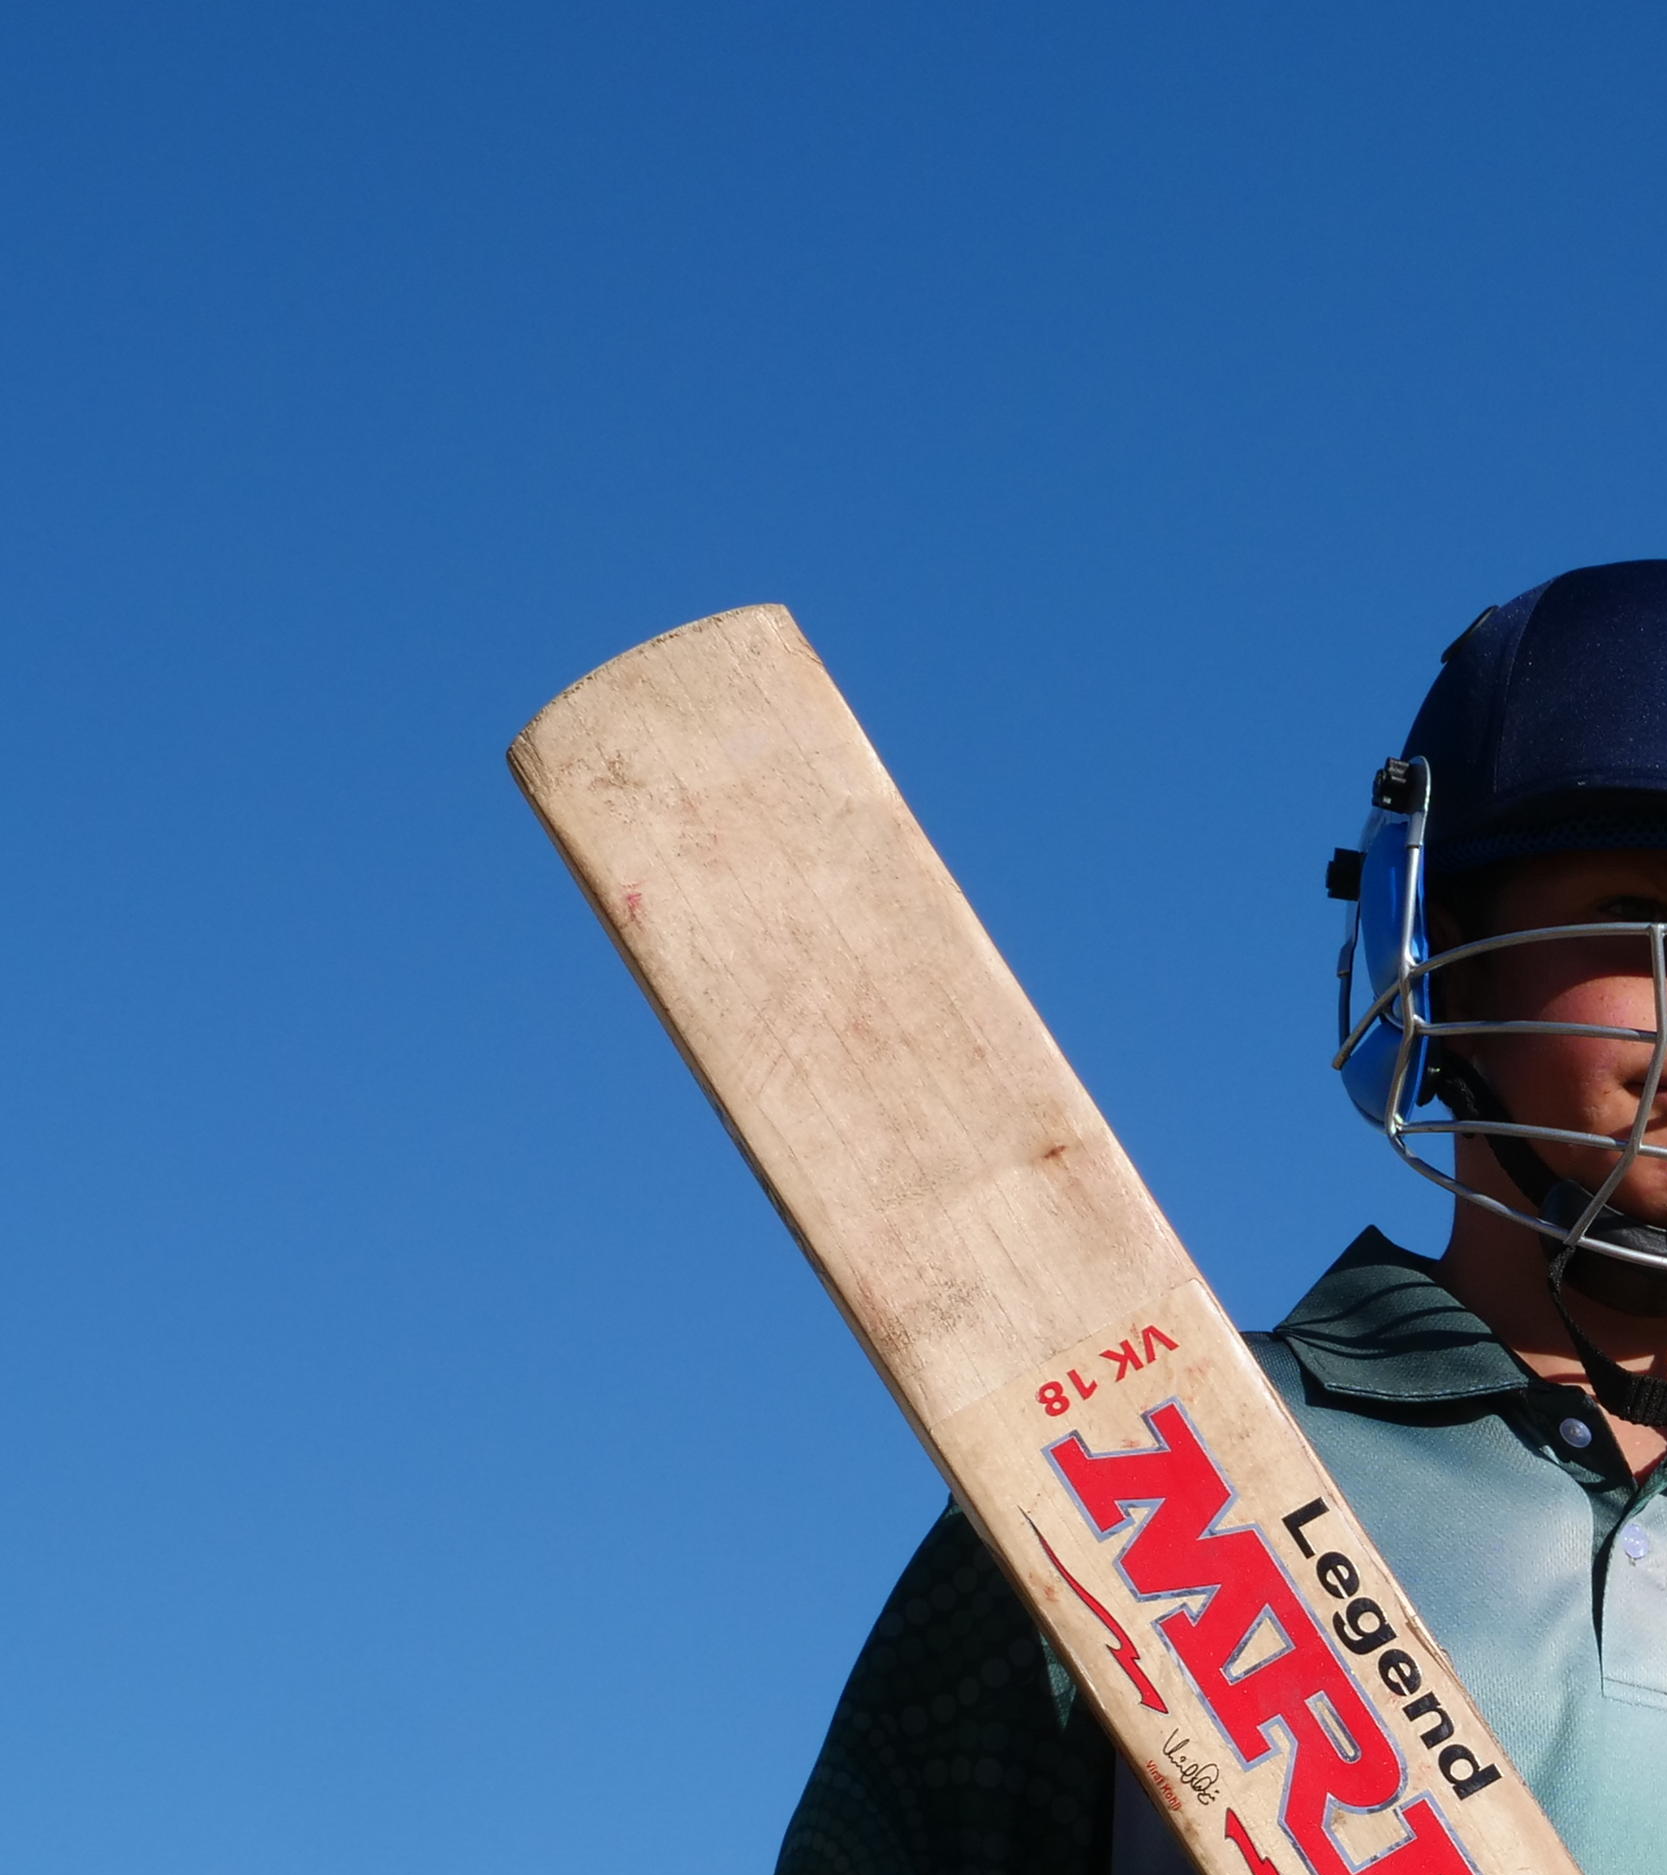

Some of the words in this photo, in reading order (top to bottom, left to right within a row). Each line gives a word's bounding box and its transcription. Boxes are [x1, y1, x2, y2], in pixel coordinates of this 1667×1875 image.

[1100, 1324, 1180, 1384] VK
[1036, 1375, 1098, 1418] 18
[1280, 1496, 1507, 1800] Legend
